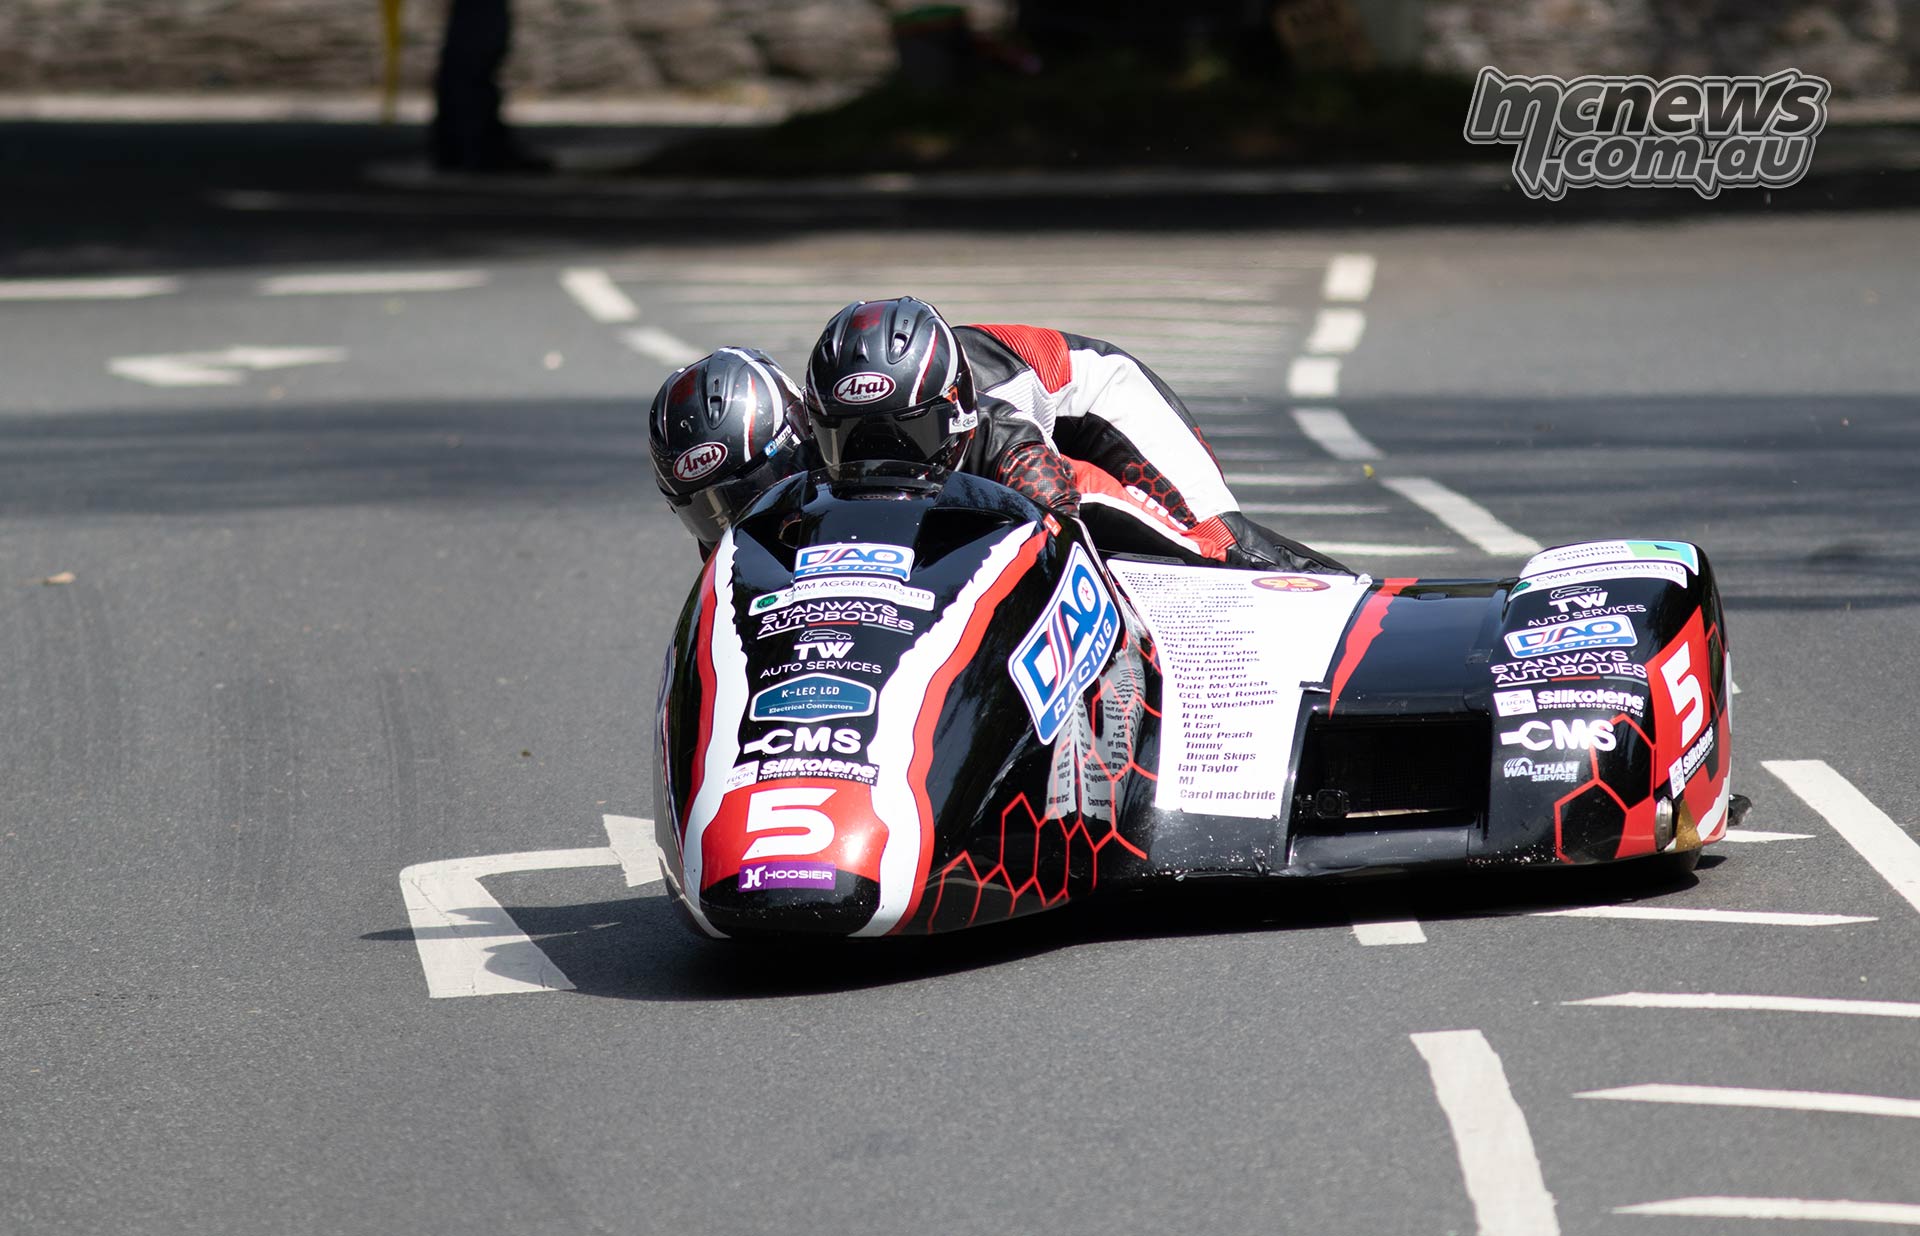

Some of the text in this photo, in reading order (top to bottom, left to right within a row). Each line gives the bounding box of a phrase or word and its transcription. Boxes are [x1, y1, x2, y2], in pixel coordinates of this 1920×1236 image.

[839, 377, 886, 397] Arai
[679, 444, 719, 478] Arai
[1557, 549, 1629, 562] Solutions
[803, 566, 895, 574] RACING
[1536, 564, 1685, 583] CWM AGGREGATES LTD
[820, 579, 905, 596] AGGREGATES
[909, 591, 931, 601] LTD
[1548, 591, 1609, 613] TW
[762, 601, 898, 625] STANWAYS
[1527, 604, 1647, 627] AUTO SERVICES
[758, 611, 915, 636] AUTOBODIES
[794, 641, 855, 661] TW
[1531, 637, 1619, 654] RACING
[1169, 656, 1200, 664] Colin
[1172, 664, 1192, 672] Pip
[1490, 650, 1629, 674] STANWAYS
[760, 660, 883, 679] AUTO SERVICES
[1053, 618, 1113, 721] RACING
[1495, 662, 1648, 684] AUTOBODIES
[781, 686, 817, 698] K-LEC
[1176, 680, 1268, 690] Dale McVarish
[1207, 691, 1230, 699] Wet
[1235, 689, 1278, 697] Rooms
[1500, 698, 1531, 706] FUCHS
[1660, 641, 1704, 748] 5
[769, 703, 854, 714] Electrical Contractors
[1182, 699, 1274, 709] Tom Whelehan
[1579, 702, 1628, 713] MOTORCYCLE
[1630, 708, 1644, 718] OILS
[744, 726, 861, 754] CMS
[1184, 731, 1253, 739] Andy Peach
[1500, 719, 1617, 751] CMS
[1186, 752, 1257, 761] Dixon Skips
[1178, 763, 1239, 773] Ian Taylor
[1503, 759, 1580, 778] WALTHAM
[758, 771, 874, 784] SUPERIOR MOTORCYCLE OILS
[1532, 773, 1578, 782] SERVICES
[1180, 788, 1276, 800] Carol macbride
[741, 787, 838, 861] 5
[764, 869, 833, 881] HOOSIER
